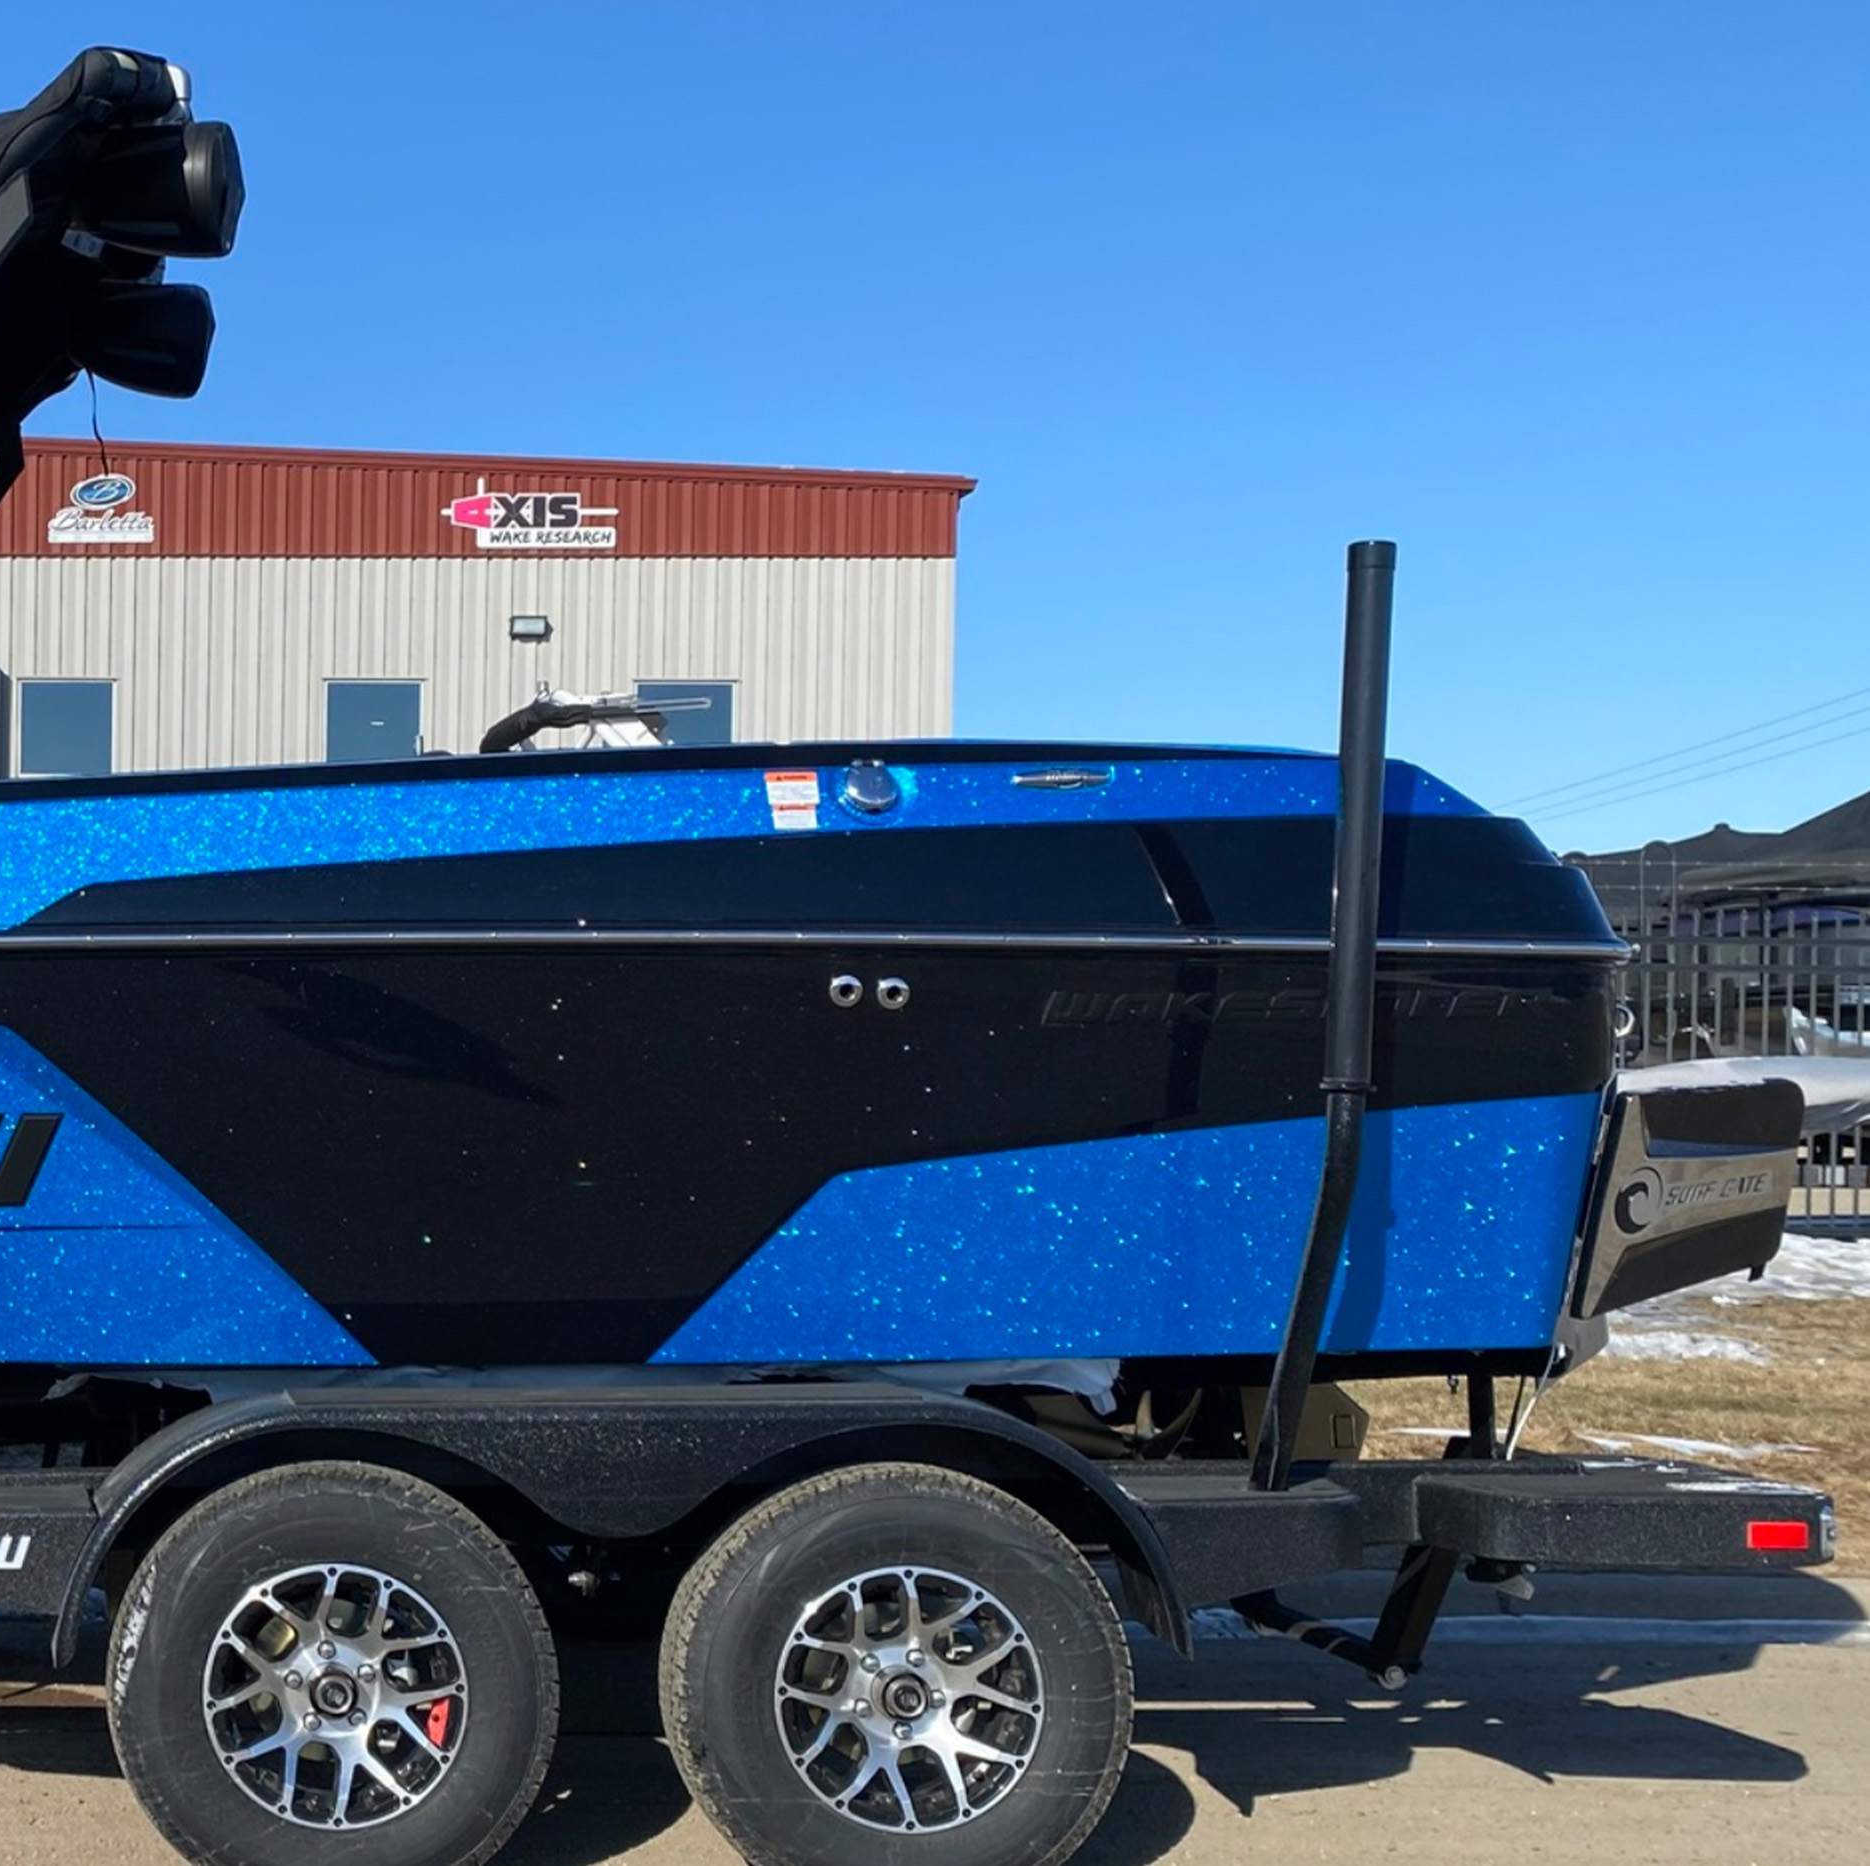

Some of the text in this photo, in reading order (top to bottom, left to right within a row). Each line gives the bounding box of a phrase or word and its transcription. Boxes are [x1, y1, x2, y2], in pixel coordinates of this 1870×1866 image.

[51, 508, 153, 531] Barletta
[453, 495, 579, 528] AXIS
[490, 530, 612, 546] WAKE RESEARCH
[1039, 987, 1558, 1028] WAKESTTER
[1665, 1181, 1718, 1206] SURF
